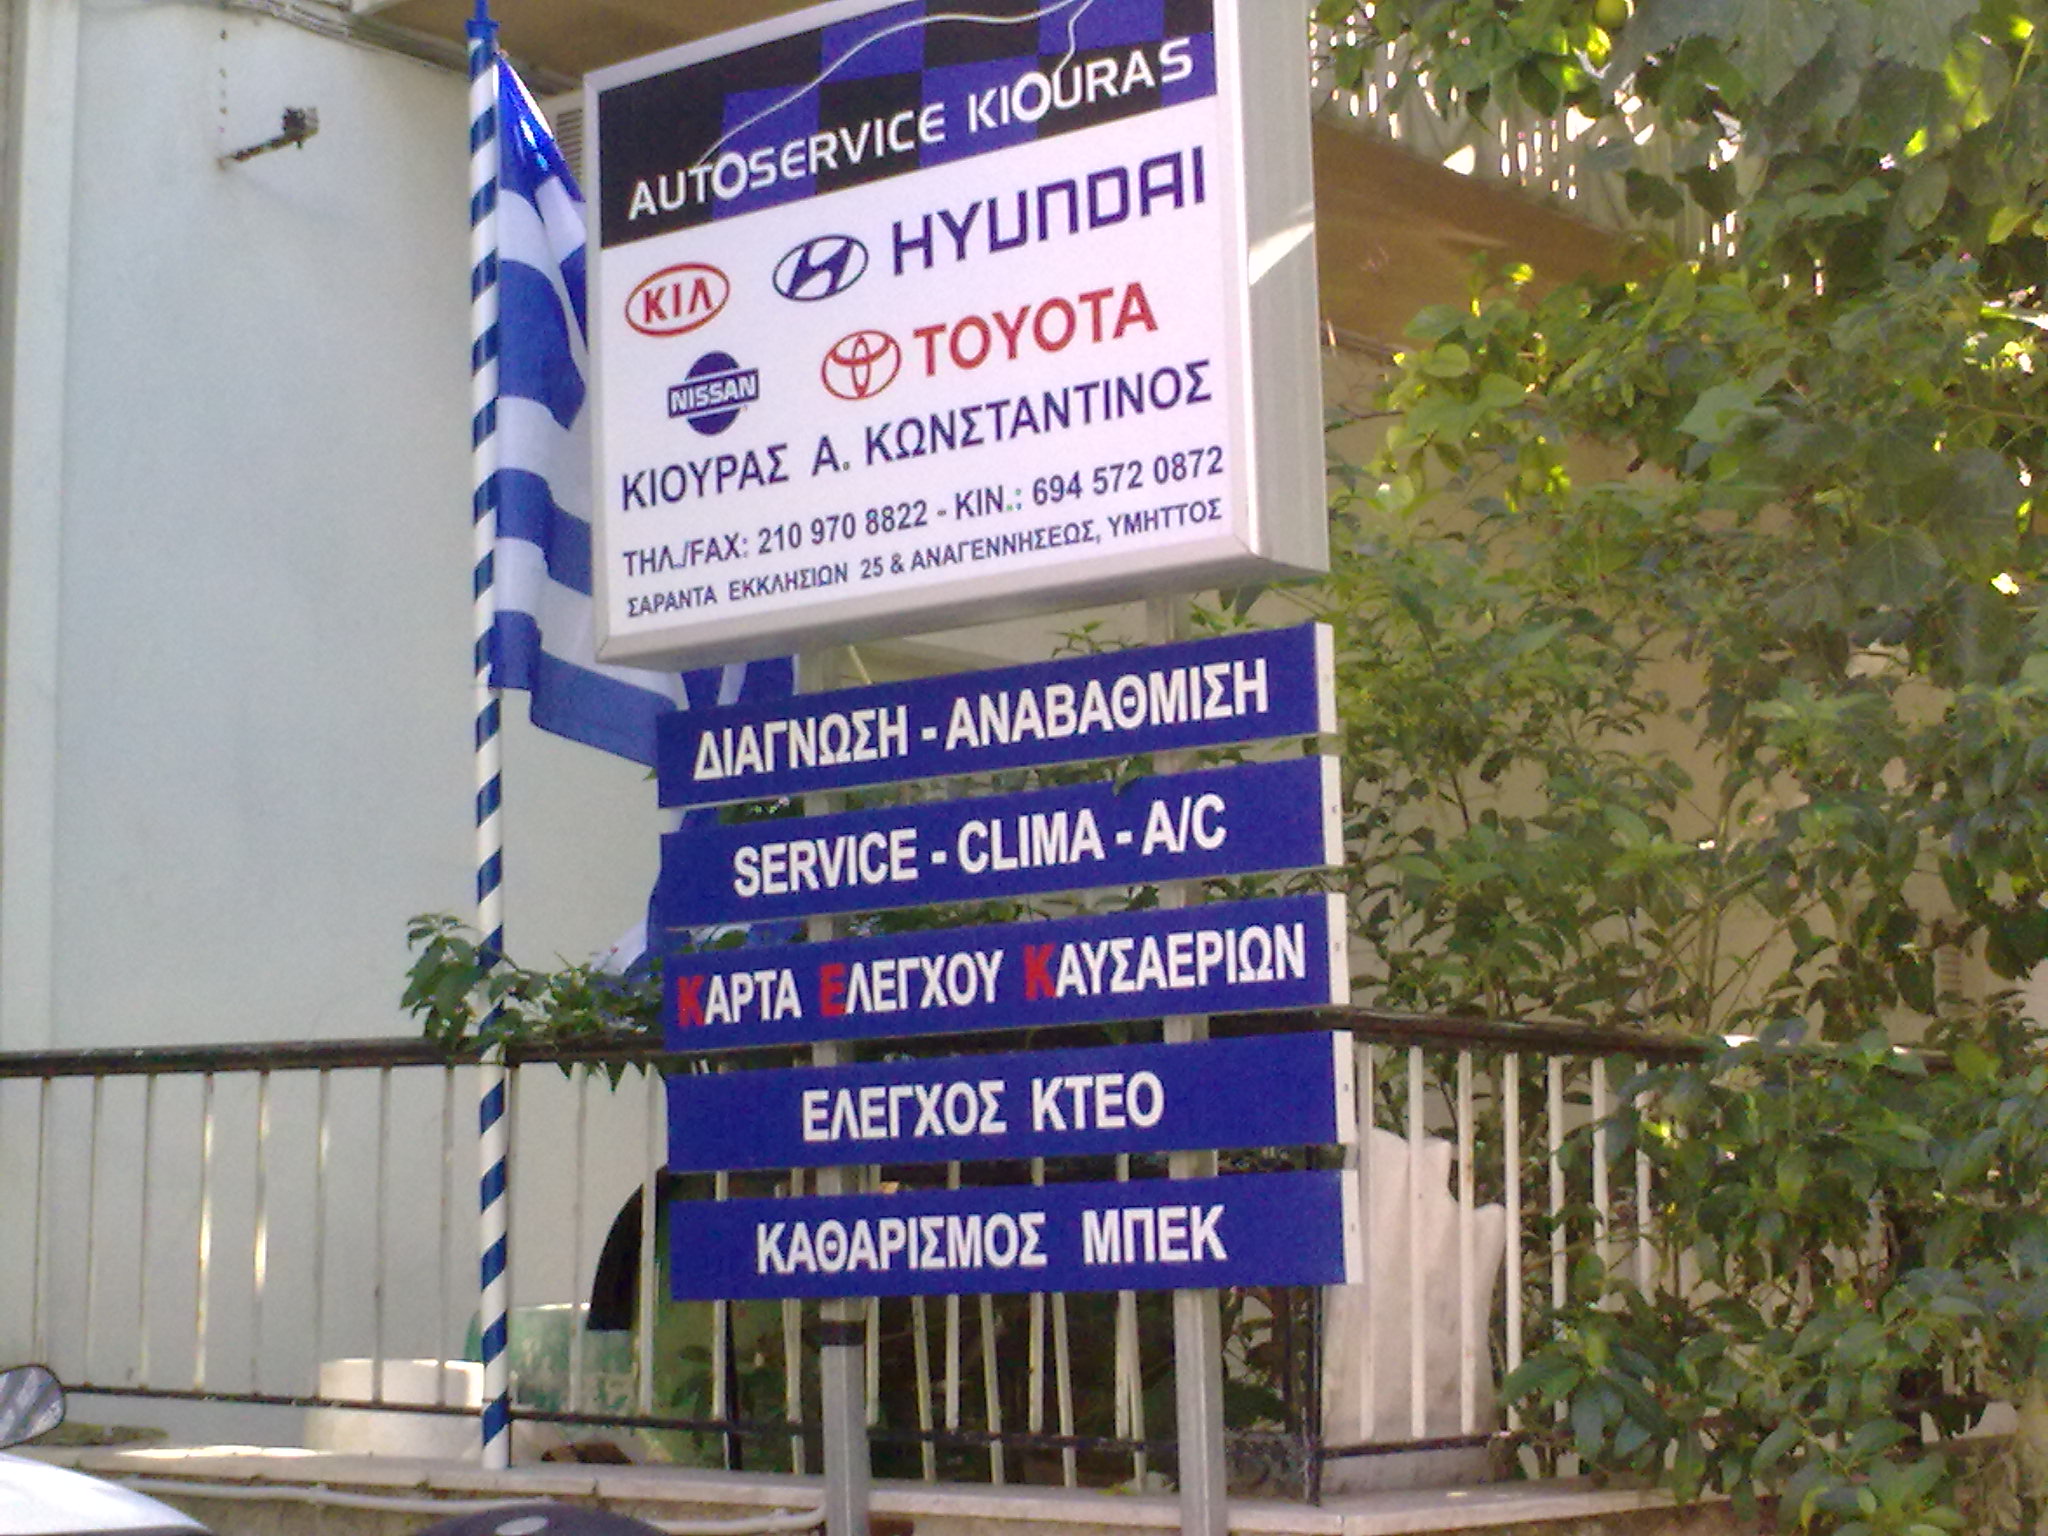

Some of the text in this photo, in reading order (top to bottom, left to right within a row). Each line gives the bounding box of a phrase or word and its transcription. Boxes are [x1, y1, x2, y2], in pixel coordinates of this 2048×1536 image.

[628, 37, 1193, 220] AUTOSERVICE KIOURAS
[892, 146, 1205, 275] HYUNDAI
[642, 277, 713, 324] KIA
[913, 281, 1159, 377] TOYOTA
[622, 359, 1212, 511] ΚΙΟΥΡΑΣ Α. ΚΩΝΣΤΑΝΤΙΝΟΣ
[670, 371, 757, 416] NISSAN
[758, 522, 801, 555] 210
[811, 512, 856, 545] 970
[865, 499, 928, 535] 8822
[1032, 470, 1082, 506] 694
[1092, 460, 1143, 496] 572
[1153, 445, 1224, 485] 0872
[627, 585, 718, 618] ΣΑΡΑΝΤΑ
[728, 562, 849, 601] ΕΚΚΛΗΣΙΩΝ
[860, 557, 883, 580] 25
[889, 553, 905, 575] &
[1107, 497, 1223, 538] ΥΜΗΤΤΟΣ
[693, 705, 909, 781] ΔΙΑΓΝΩΣΗ
[945, 657, 1269, 751] ΑΝΑΒΑΘΜΙΣΗ
[732, 828, 919, 898] SERVICE
[957, 808, 1105, 875] CLIMA
[1141, 793, 1227, 856] A/C
[677, 922, 1305, 1028] ΚΑΡΤΑ ΕΛΕΓΧΟΥ ΚΑΥΣΑΕΡΙΩΝ
[803, 1070, 1165, 1142] ΕΛΕΓΧΟΣ ΚΤΕΟ
[756, 1204, 1228, 1275] ΚΑΘΑΡΙΣΜΟΣ ΜΠΕΚ
